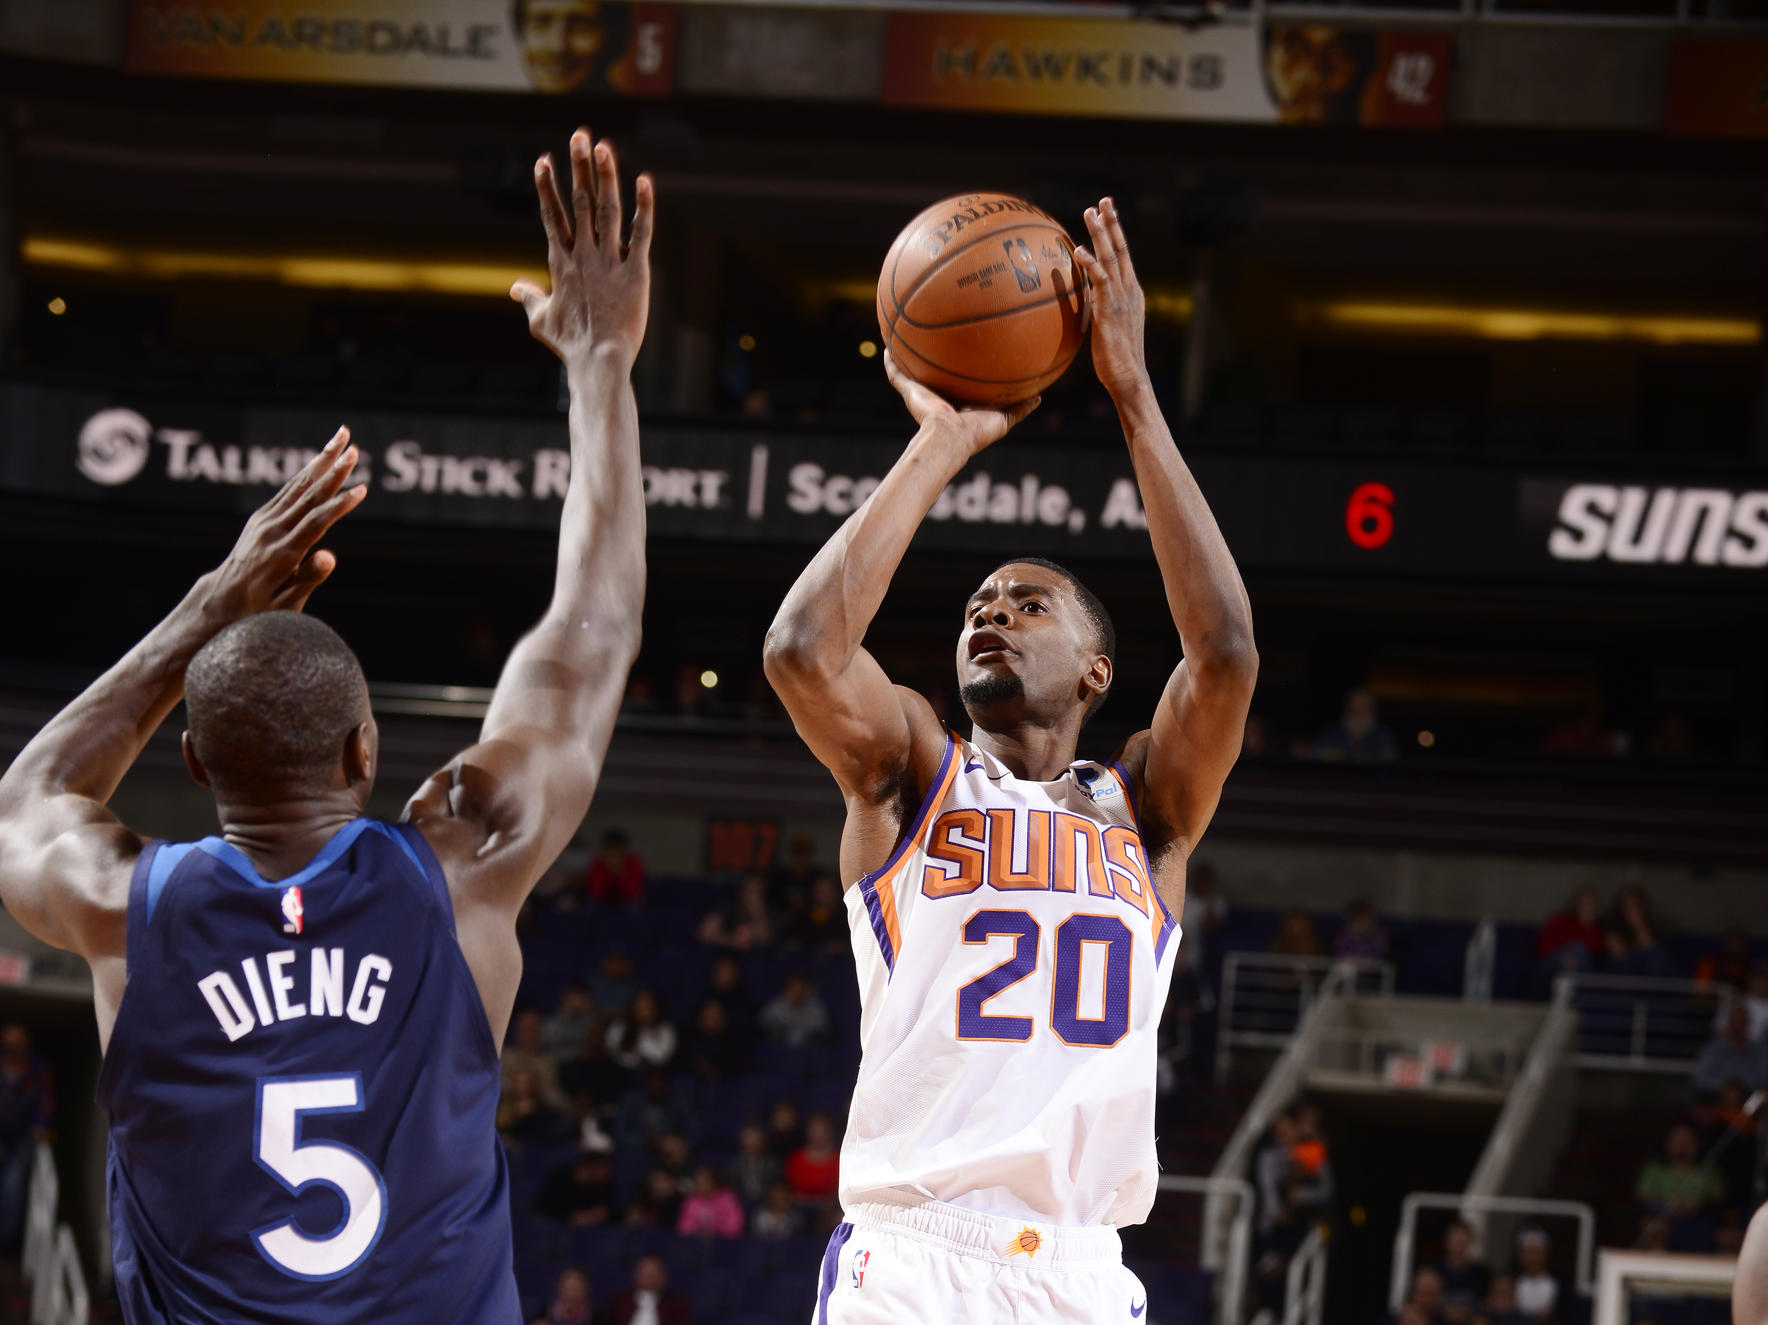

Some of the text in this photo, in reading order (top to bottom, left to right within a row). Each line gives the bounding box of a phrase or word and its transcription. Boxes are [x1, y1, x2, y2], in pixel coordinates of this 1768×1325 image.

[933, 44, 1226, 90] HAWKINS
[1386, 53, 1436, 106] 42
[157, 427, 372, 488] TALKIG
[787, 463, 1149, 534] Scosdale, A
[1345, 482, 1396, 551] 6
[921, 809, 1150, 918] SUNS
[197, 948, 394, 1042] DIENG
[955, 908, 1134, 1048] 20
[251, 1071, 388, 1282] 5
